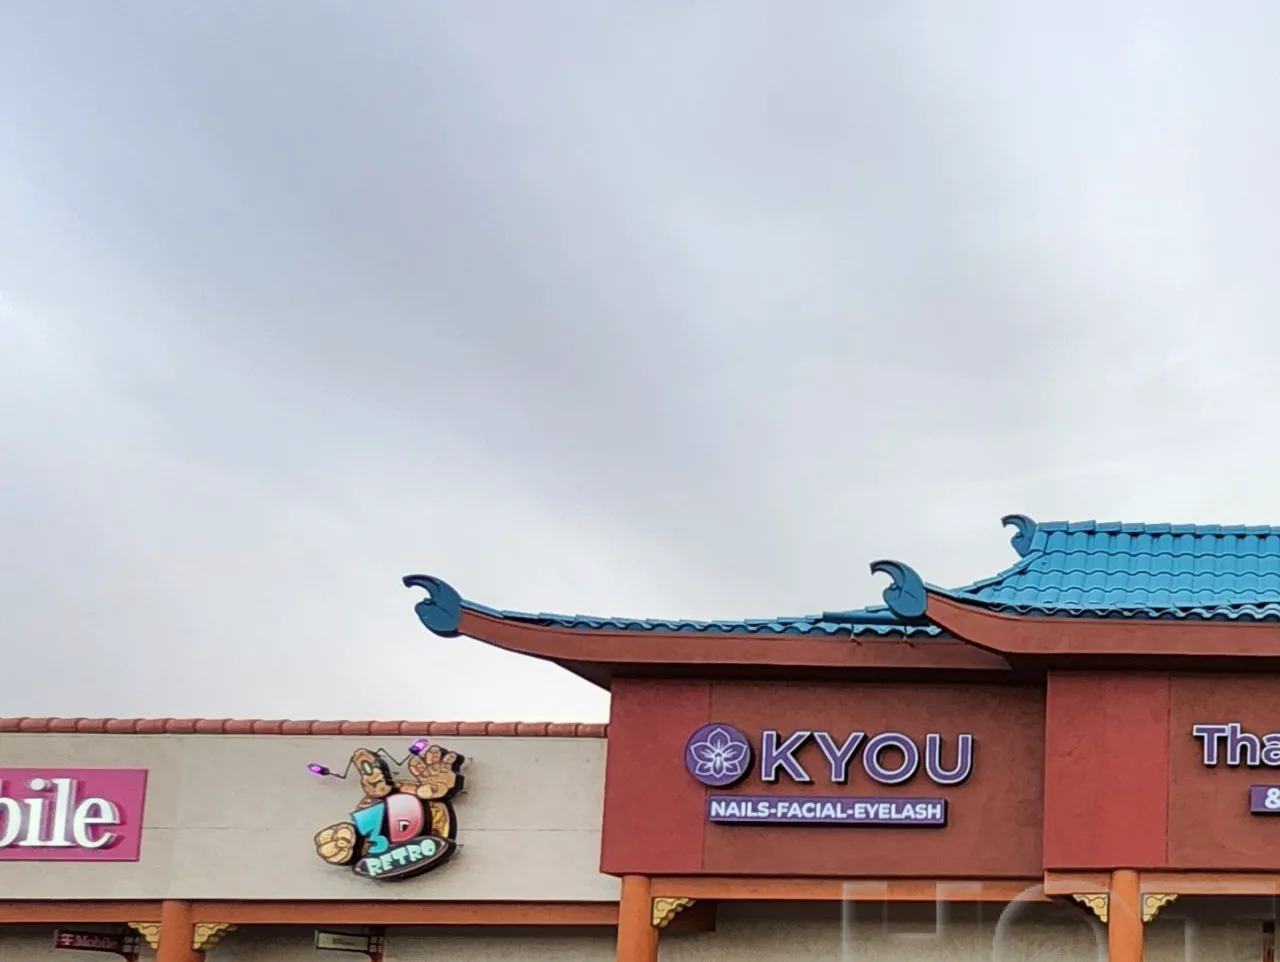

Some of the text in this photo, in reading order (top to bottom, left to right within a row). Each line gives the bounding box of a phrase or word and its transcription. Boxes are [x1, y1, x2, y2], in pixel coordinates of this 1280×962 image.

[761, 731, 973, 785] KYOU
[350, 792, 425, 855] 3D
[710, 800, 942, 820] NAILS-FACIAL-EYELASH
[365, 838, 437, 877] RETRO
